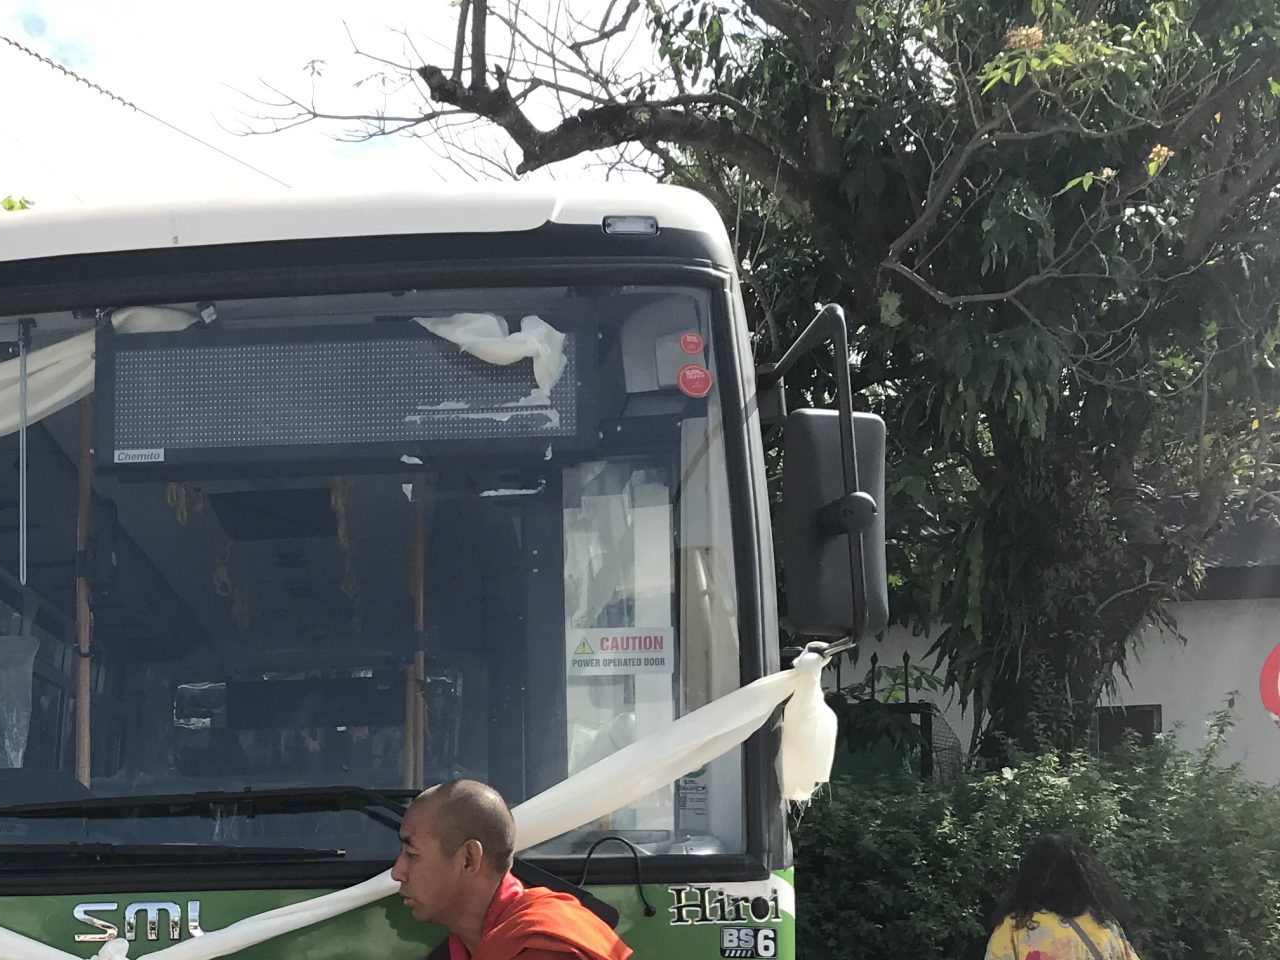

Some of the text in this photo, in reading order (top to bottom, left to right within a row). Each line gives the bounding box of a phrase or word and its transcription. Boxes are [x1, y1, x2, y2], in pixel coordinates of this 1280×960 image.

[600, 636, 664, 651] CAUTION
[573, 658, 665, 668] POWER OPERATED DOOR
[668, 886, 782, 925] Hiroi
[73, 901, 205, 942] SML
